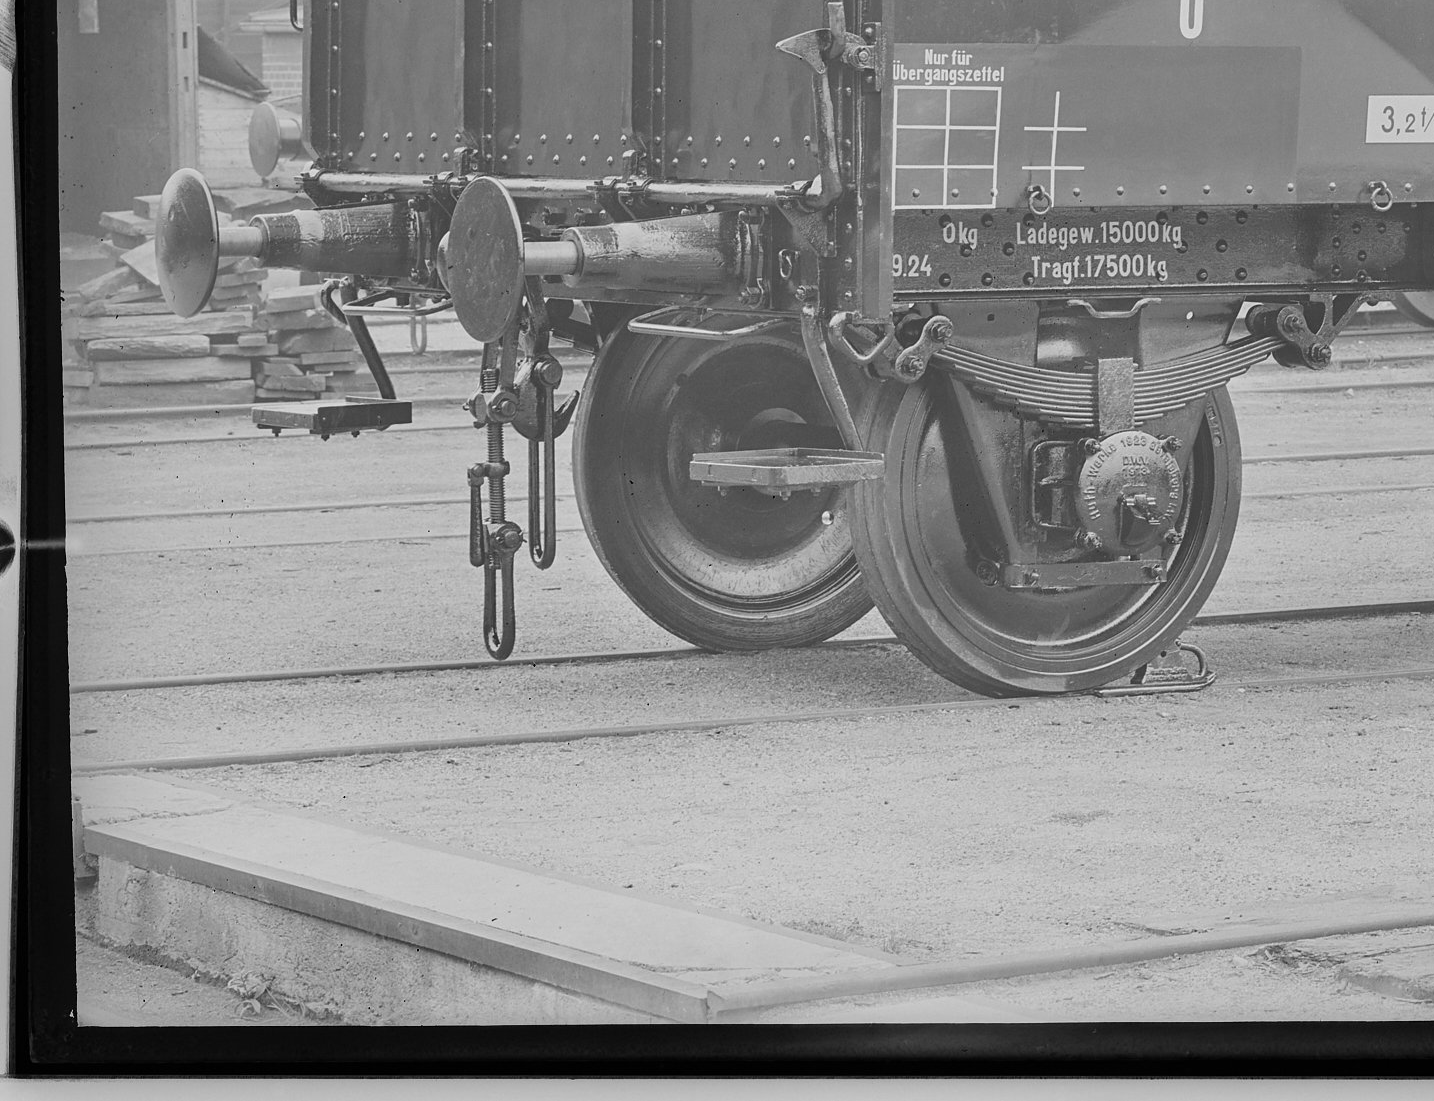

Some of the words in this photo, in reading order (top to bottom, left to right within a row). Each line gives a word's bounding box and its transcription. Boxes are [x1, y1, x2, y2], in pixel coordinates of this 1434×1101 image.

[924, 48, 949, 66] Nur
[951, 49, 973, 66] für
[892, 59, 1005, 86] Übergangszettel
[1381, 105, 1416, 136] 3,2
